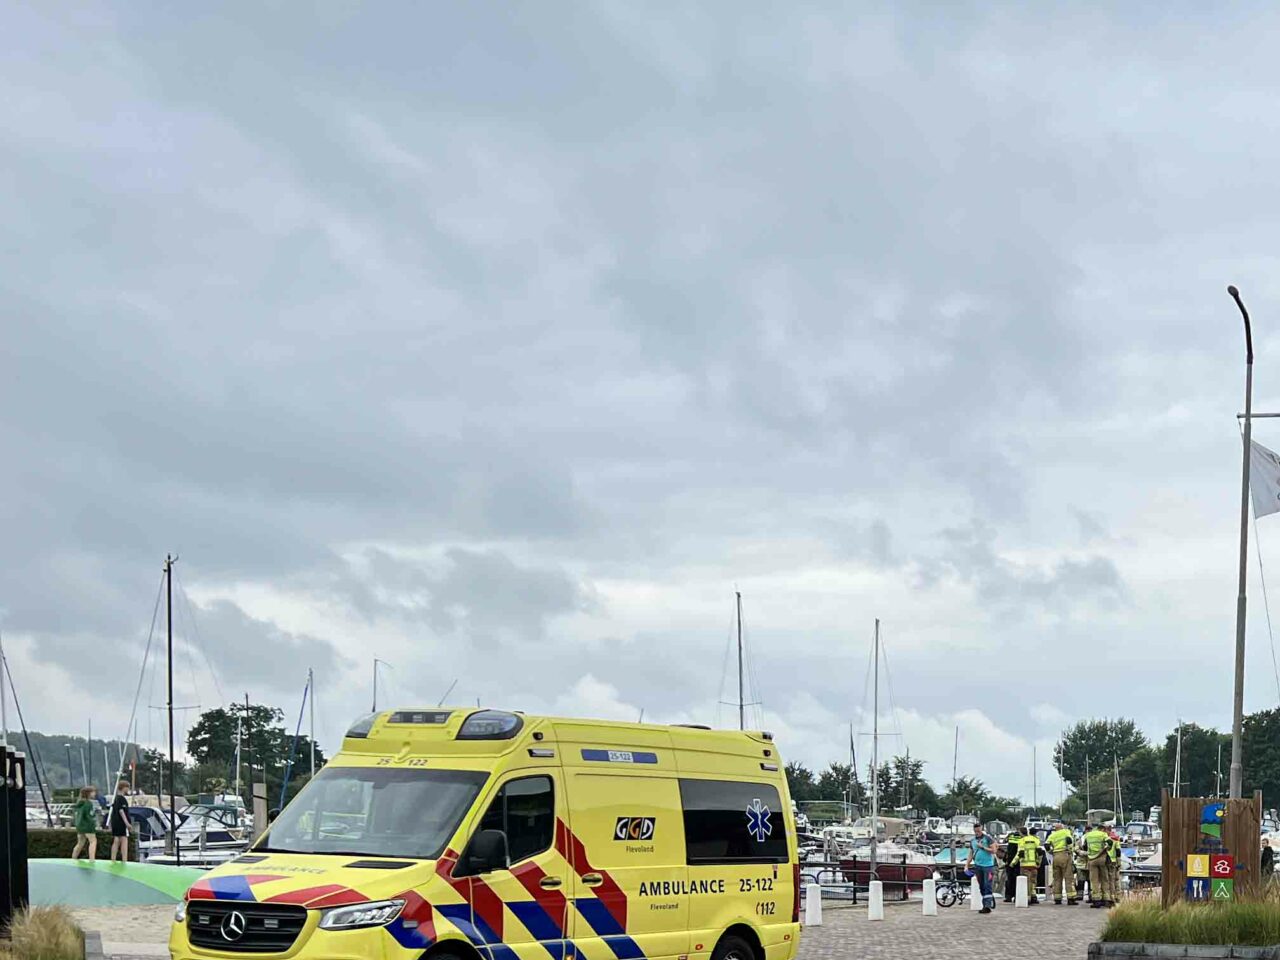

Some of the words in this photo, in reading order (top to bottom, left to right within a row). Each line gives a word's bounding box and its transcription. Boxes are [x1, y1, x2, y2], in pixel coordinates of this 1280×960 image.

[616, 818, 654, 840] GGD
[626, 845, 654, 853] Flevoland
[639, 880, 725, 897] AMBULANCE
[739, 878, 773, 892] 25-122
